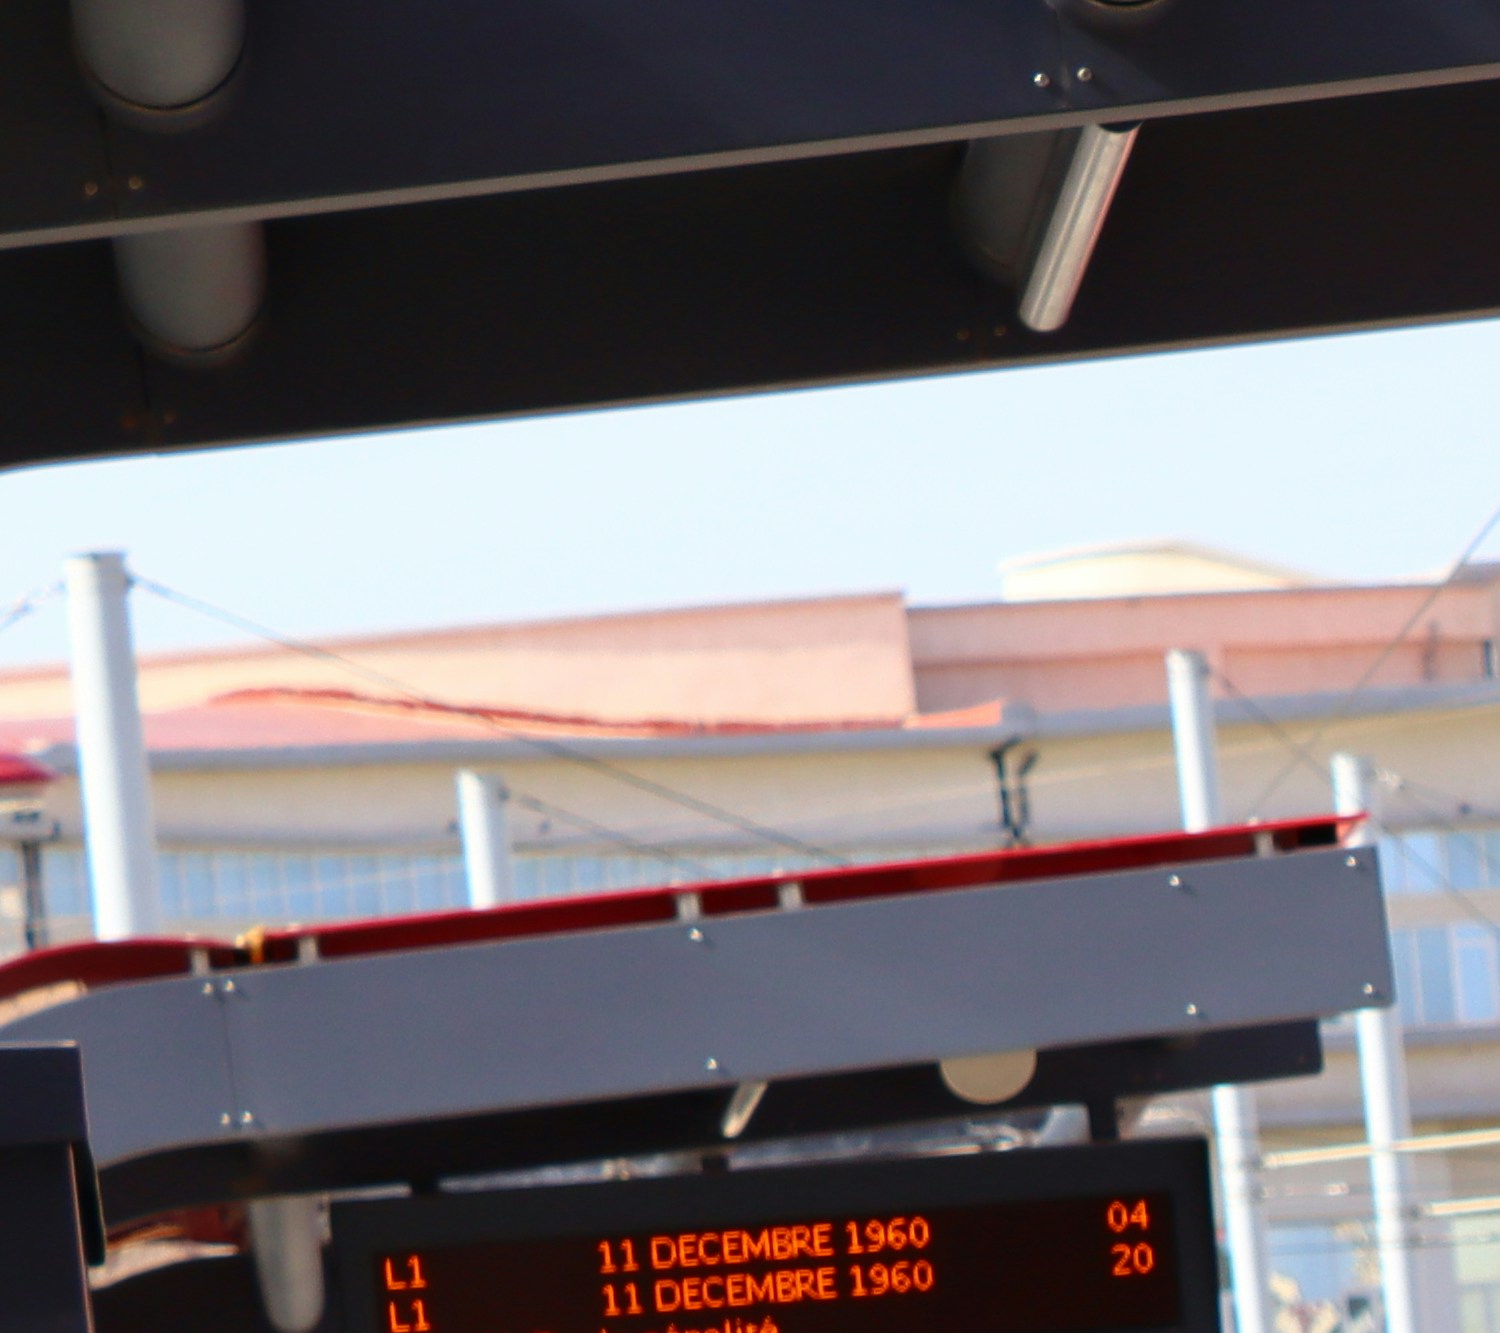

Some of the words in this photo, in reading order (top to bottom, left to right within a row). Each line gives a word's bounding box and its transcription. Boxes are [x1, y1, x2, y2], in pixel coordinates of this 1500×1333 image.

[385, 1255, 428, 1291] L1
[598, 1238, 640, 1274] 11
[651, 1222, 835, 1270] DECEMBRE
[845, 1216, 931, 1255] 1960
[1106, 1199, 1149, 1233] 04
[389, 1299, 431, 1333] L1
[602, 1281, 644, 1317] 11
[654, 1266, 838, 1313] DECEMBRE
[849, 1258, 935, 1297] 1960
[1110, 1241, 1155, 1277] 20
